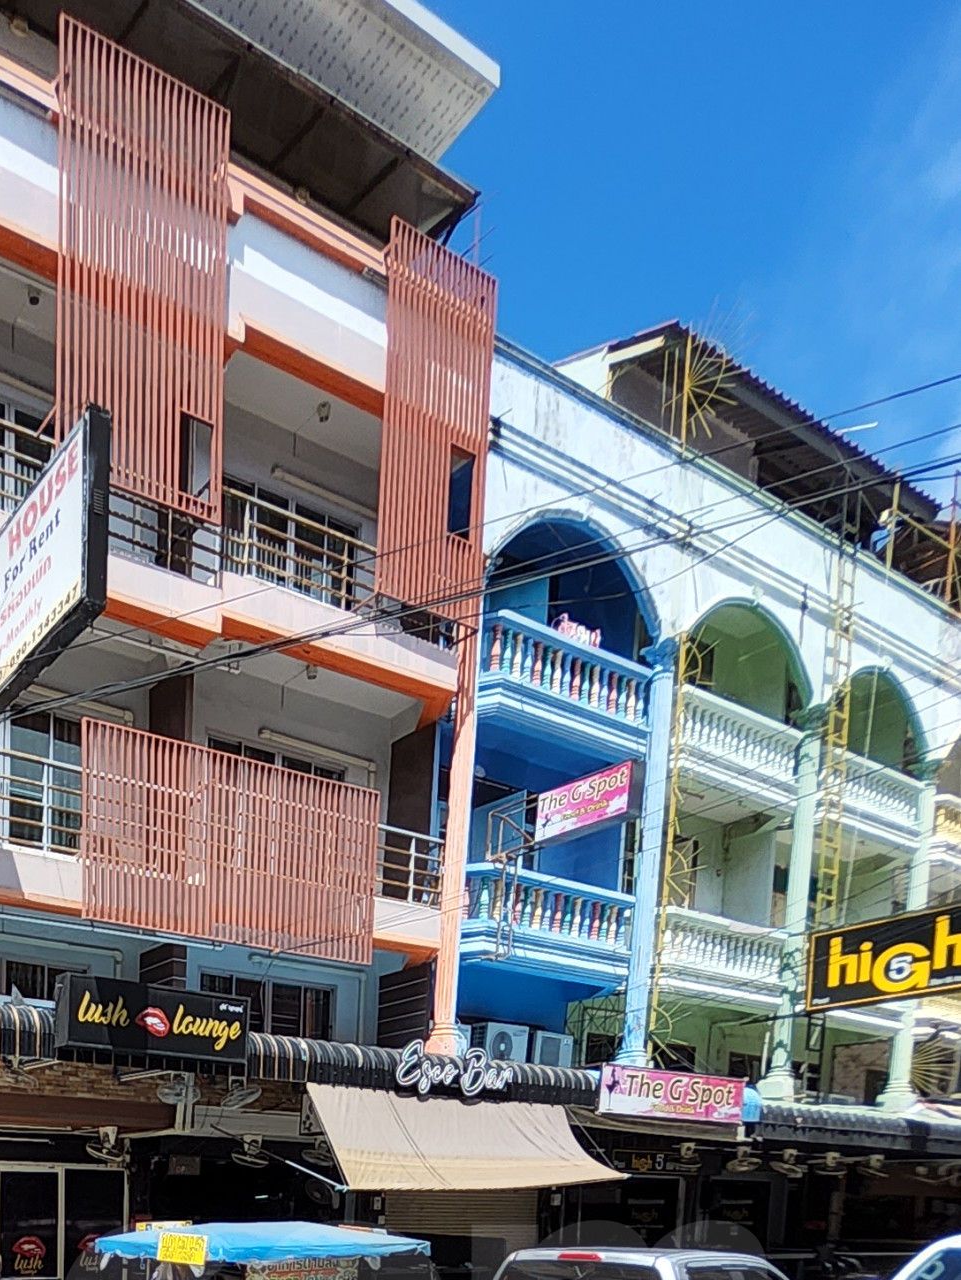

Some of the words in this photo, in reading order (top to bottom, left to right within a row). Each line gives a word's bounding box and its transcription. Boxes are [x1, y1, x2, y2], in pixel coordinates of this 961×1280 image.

[7, 438, 79, 560] HOUSE
[3, 552, 26, 594] For
[28, 507, 61, 563] Rent
[540, 793, 567, 813] The
[571, 784, 582, 801] G
[587, 769, 628, 798] Spot
[77, 990, 130, 1027] lush
[172, 1004, 242, 1051] lounge
[460, 1047, 514, 1097] Bar
[626, 1074, 664, 1099] The
[669, 1078, 684, 1101] G
[688, 1081, 734, 1109] Spot
[14, 1254, 44, 1270] lush
[79, 1252, 101, 1268] lus
